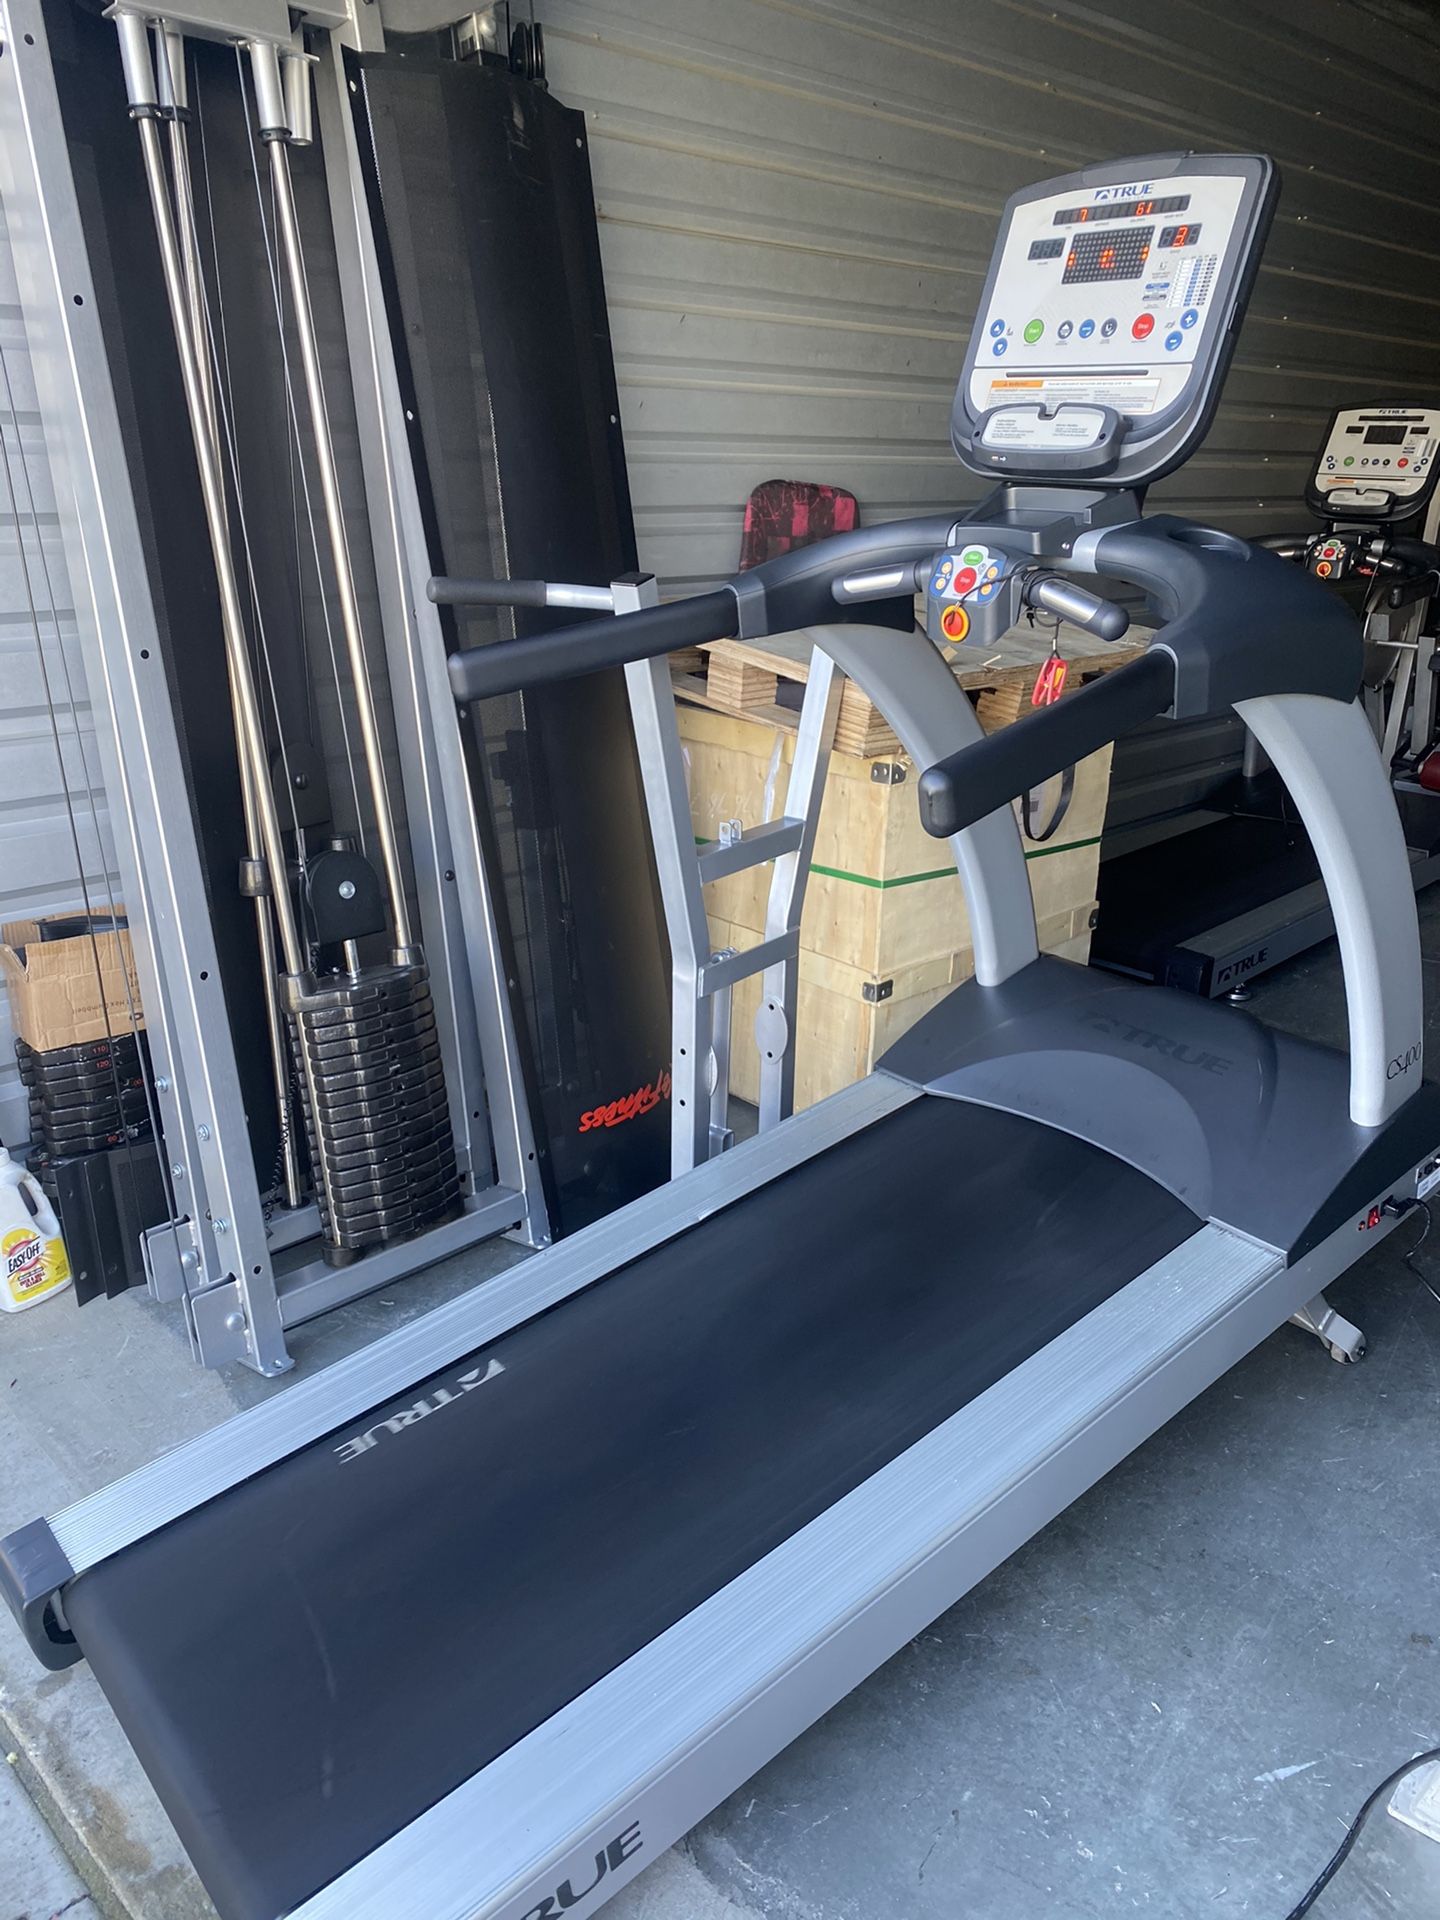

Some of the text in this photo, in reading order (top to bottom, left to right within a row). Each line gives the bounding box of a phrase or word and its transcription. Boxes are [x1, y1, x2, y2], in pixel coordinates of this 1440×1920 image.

[1112, 183, 1154, 197] TRUE
[1233, 947, 1268, 976] TRUE
[1125, 1024, 1235, 1076] TRUE
[1387, 1041, 1421, 1080] CS400
[333, 1388, 464, 1464] TRUE
[520, 1820, 643, 1920] RUE
